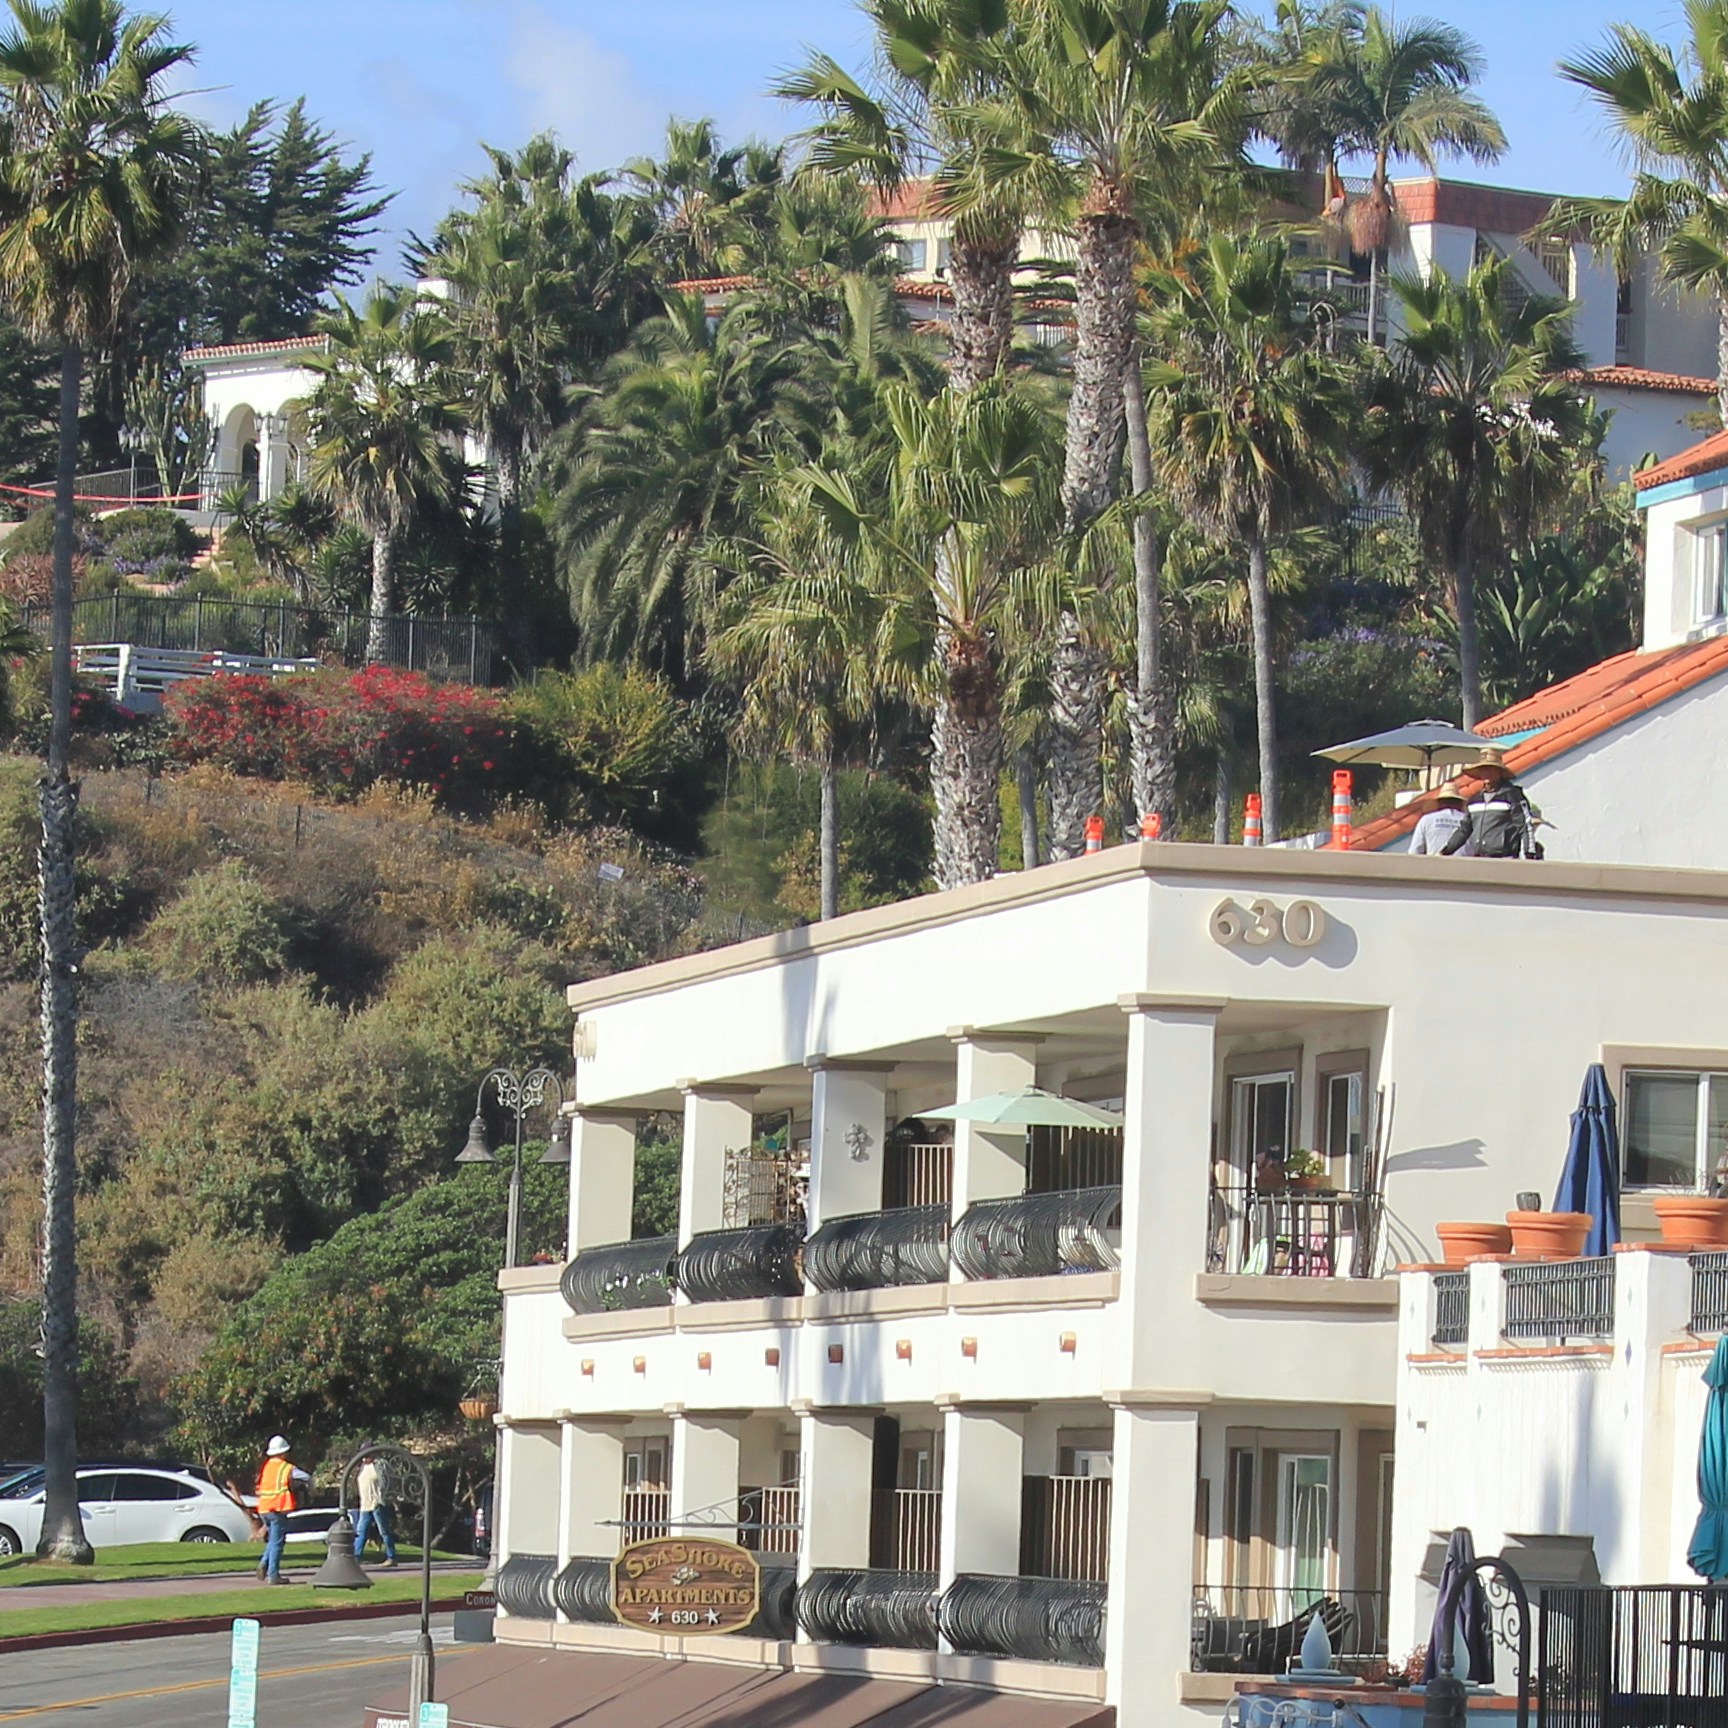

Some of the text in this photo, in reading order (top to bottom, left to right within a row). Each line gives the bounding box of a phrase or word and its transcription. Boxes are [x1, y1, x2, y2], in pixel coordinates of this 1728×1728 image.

[1209, 897, 1325, 947] 630
[622, 1588, 751, 1605] APARTMENTS
[671, 1610, 699, 1624] 630
